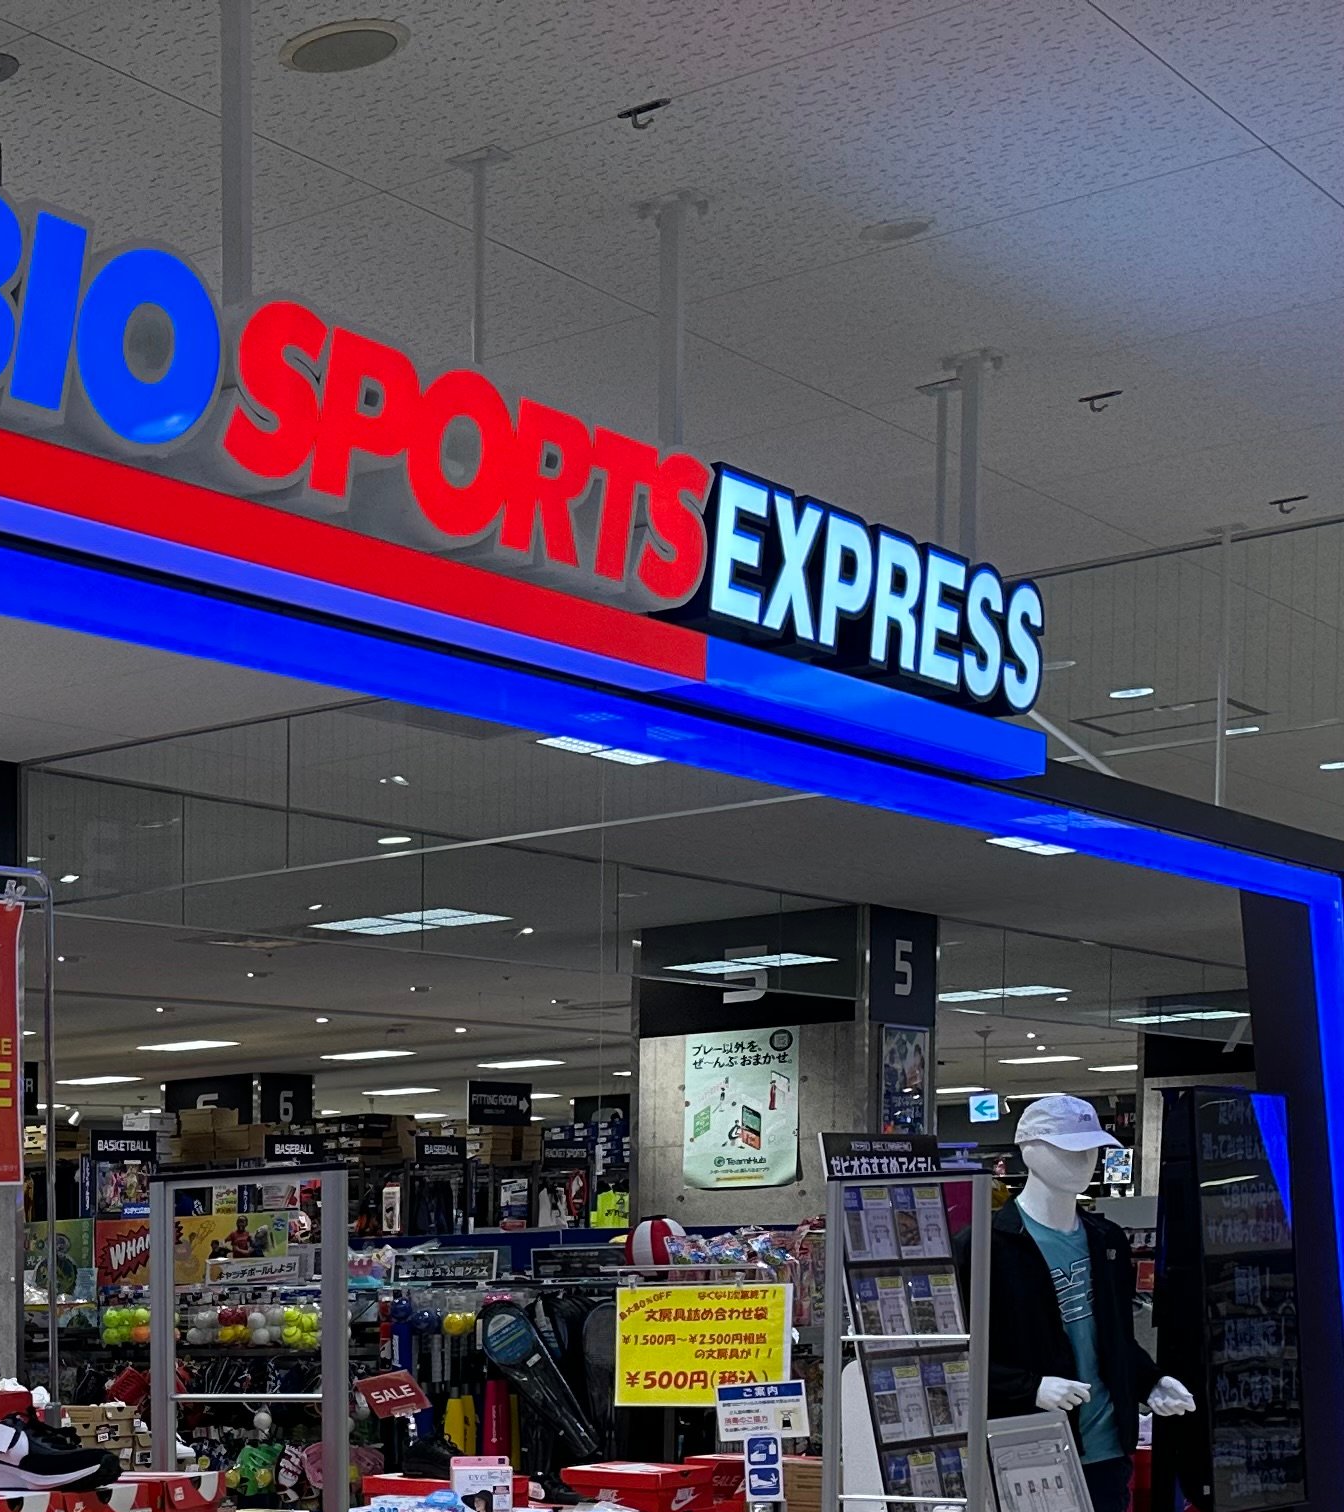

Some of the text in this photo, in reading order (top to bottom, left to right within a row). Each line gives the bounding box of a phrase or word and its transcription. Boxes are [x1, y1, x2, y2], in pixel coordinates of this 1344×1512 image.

[223, 300, 713, 599] SPORTS
[711, 467, 1043, 712] EXPRESS
[723, 945, 768, 1004] 5
[894, 939, 912, 997] 5
[279, 1090, 294, 1123] 6
[97, 1140, 151, 1152] BASKETBALL
[274, 1143, 314, 1155] BASEBALL
[424, 1144, 459, 1156] BASEBALL
[726, 1156, 767, 1165] TeamHub
[370, 1382, 416, 1405] SALE
[743, 1385, 779, 1397] ご案内
